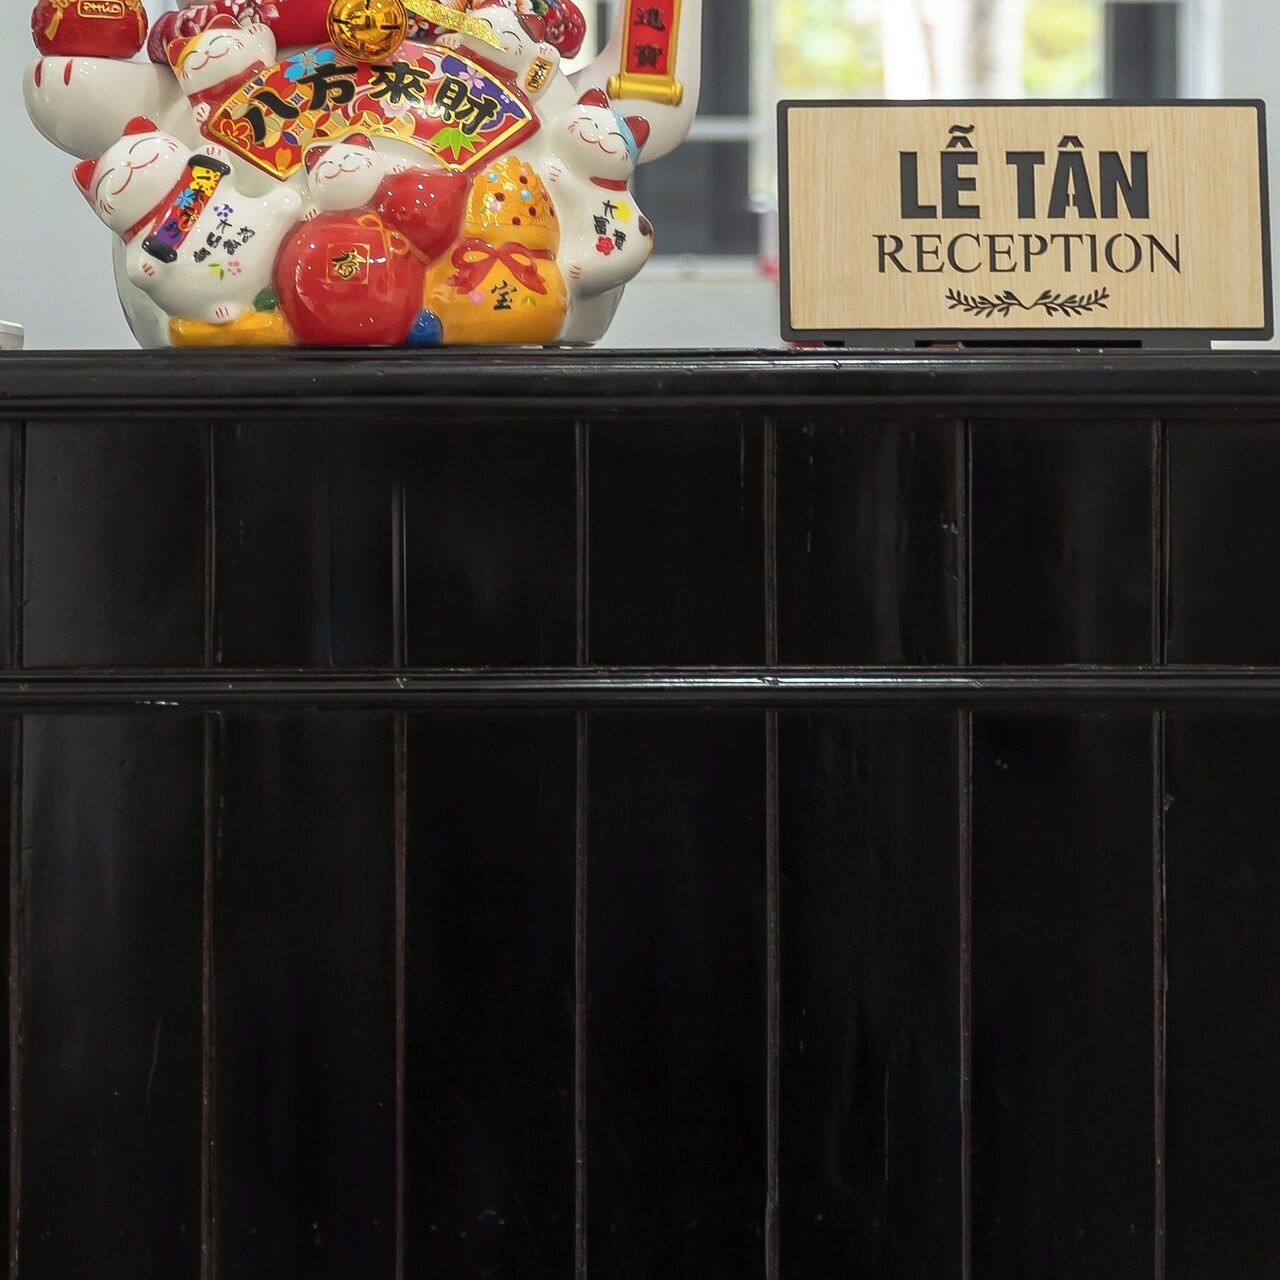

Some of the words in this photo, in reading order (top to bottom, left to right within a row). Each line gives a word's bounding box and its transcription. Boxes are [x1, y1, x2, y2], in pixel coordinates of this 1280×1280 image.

[899, 124, 981, 220] LỄ
[1005, 135, 1150, 220] TÂN
[872, 233, 1182, 274] RECEPTION
